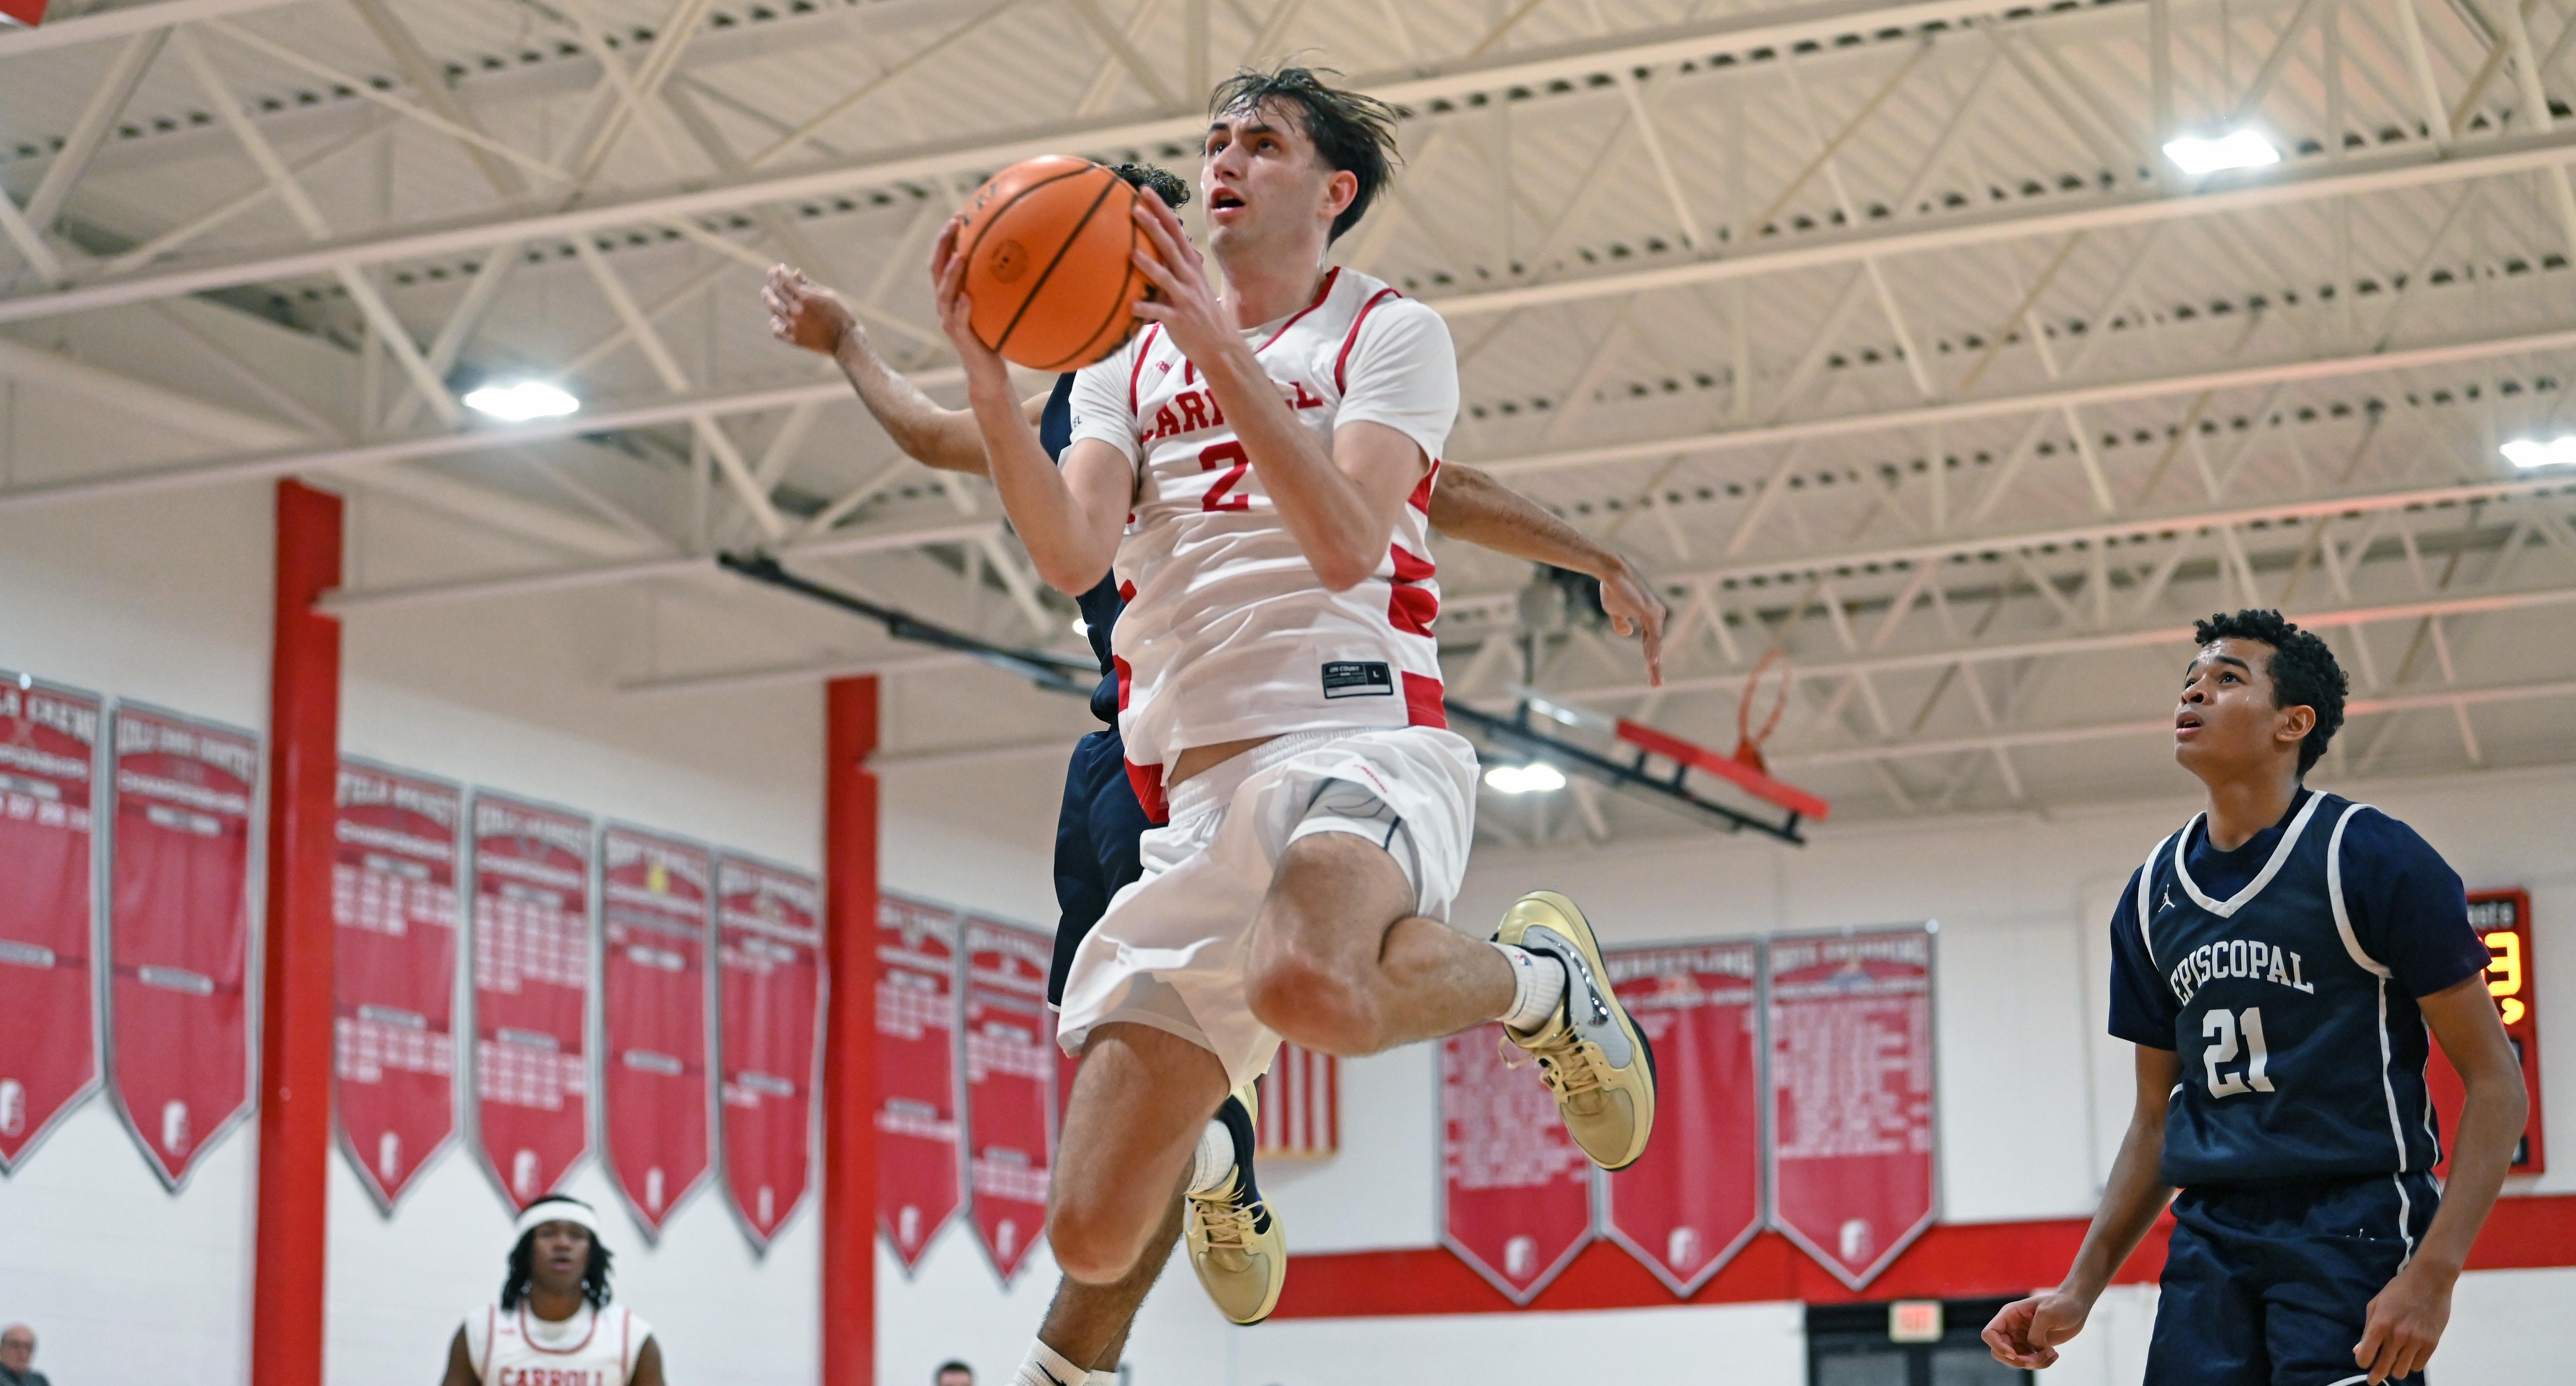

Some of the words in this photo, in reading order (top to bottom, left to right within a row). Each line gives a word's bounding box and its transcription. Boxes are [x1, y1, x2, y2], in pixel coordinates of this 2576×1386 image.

[1199, 440, 1249, 511] 2
[2170, 939, 2314, 1007] EPISCOPAL
[2202, 1007, 2275, 1100] 21
